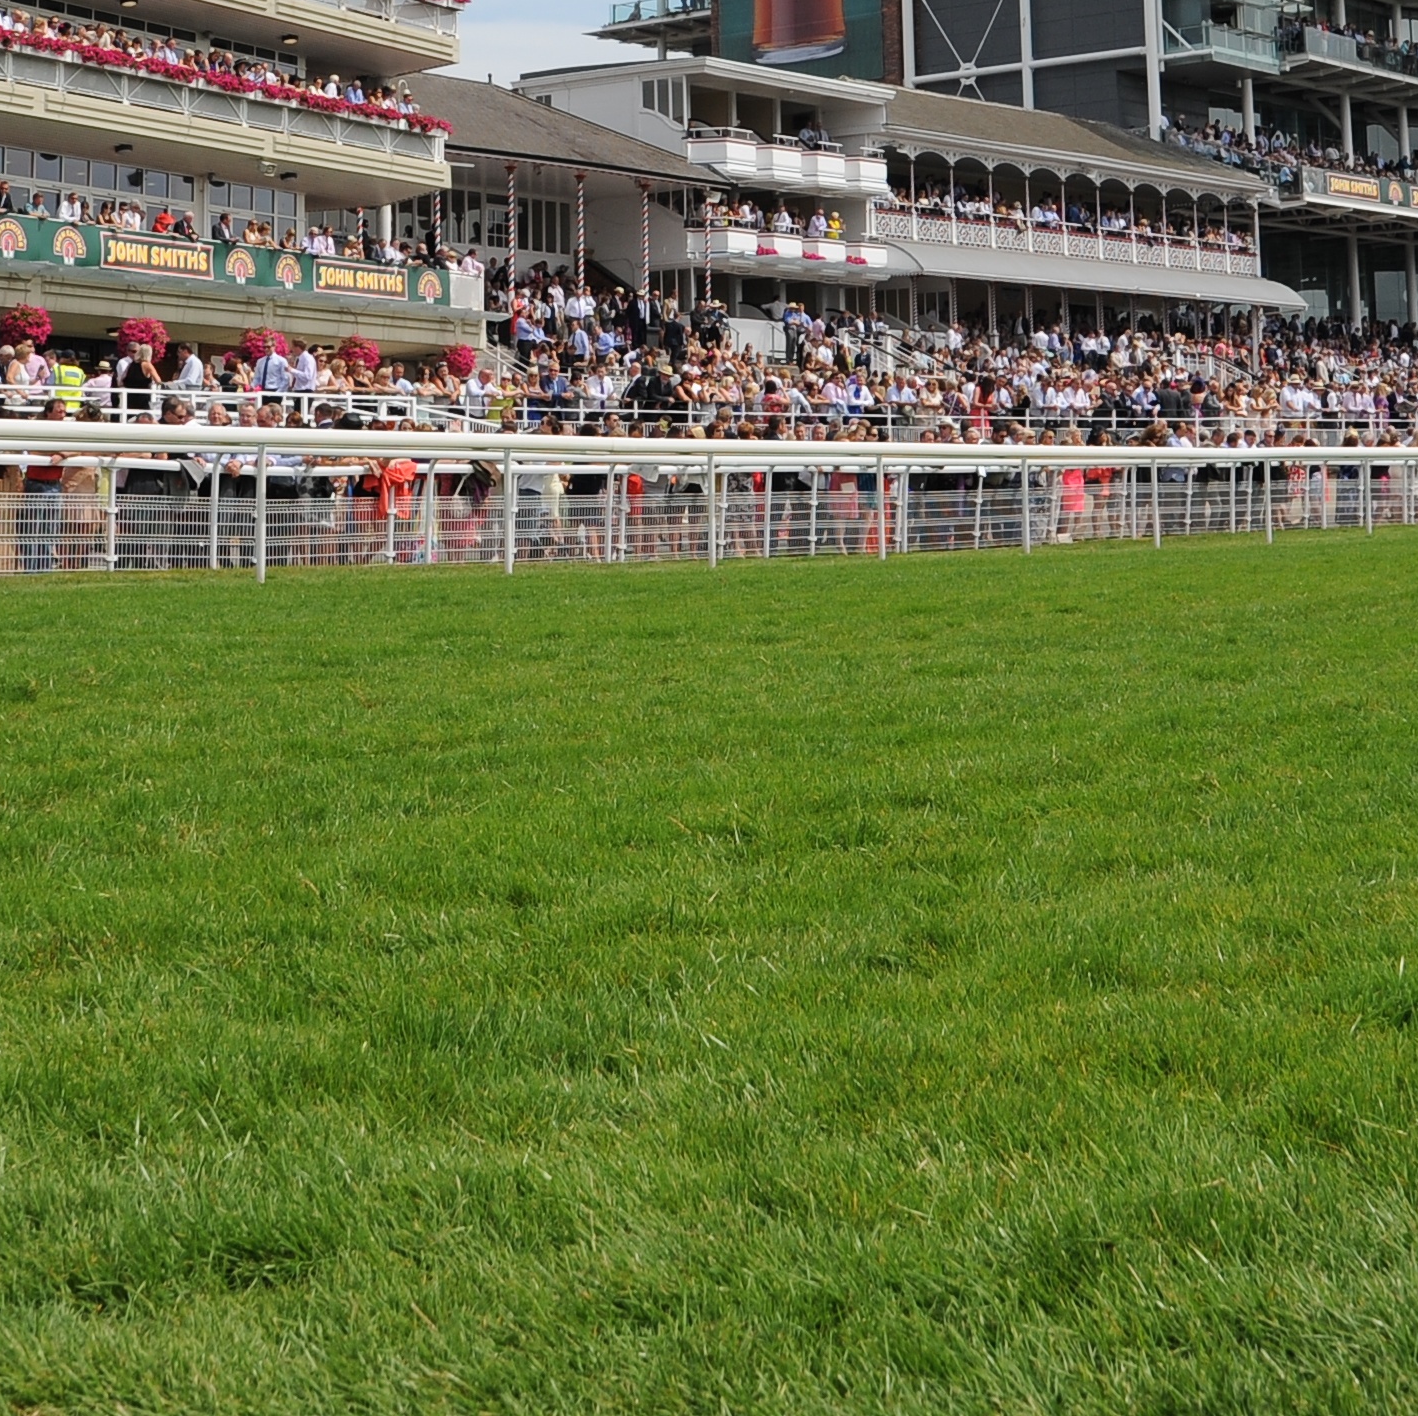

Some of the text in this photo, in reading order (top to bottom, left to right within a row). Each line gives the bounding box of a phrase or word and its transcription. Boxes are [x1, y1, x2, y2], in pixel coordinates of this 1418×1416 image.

[107, 239, 149, 264] JOHN
[150, 242, 208, 272] SMITH'S
[318, 265, 355, 288] JOHN
[355, 265, 404, 293] SMITH'S
